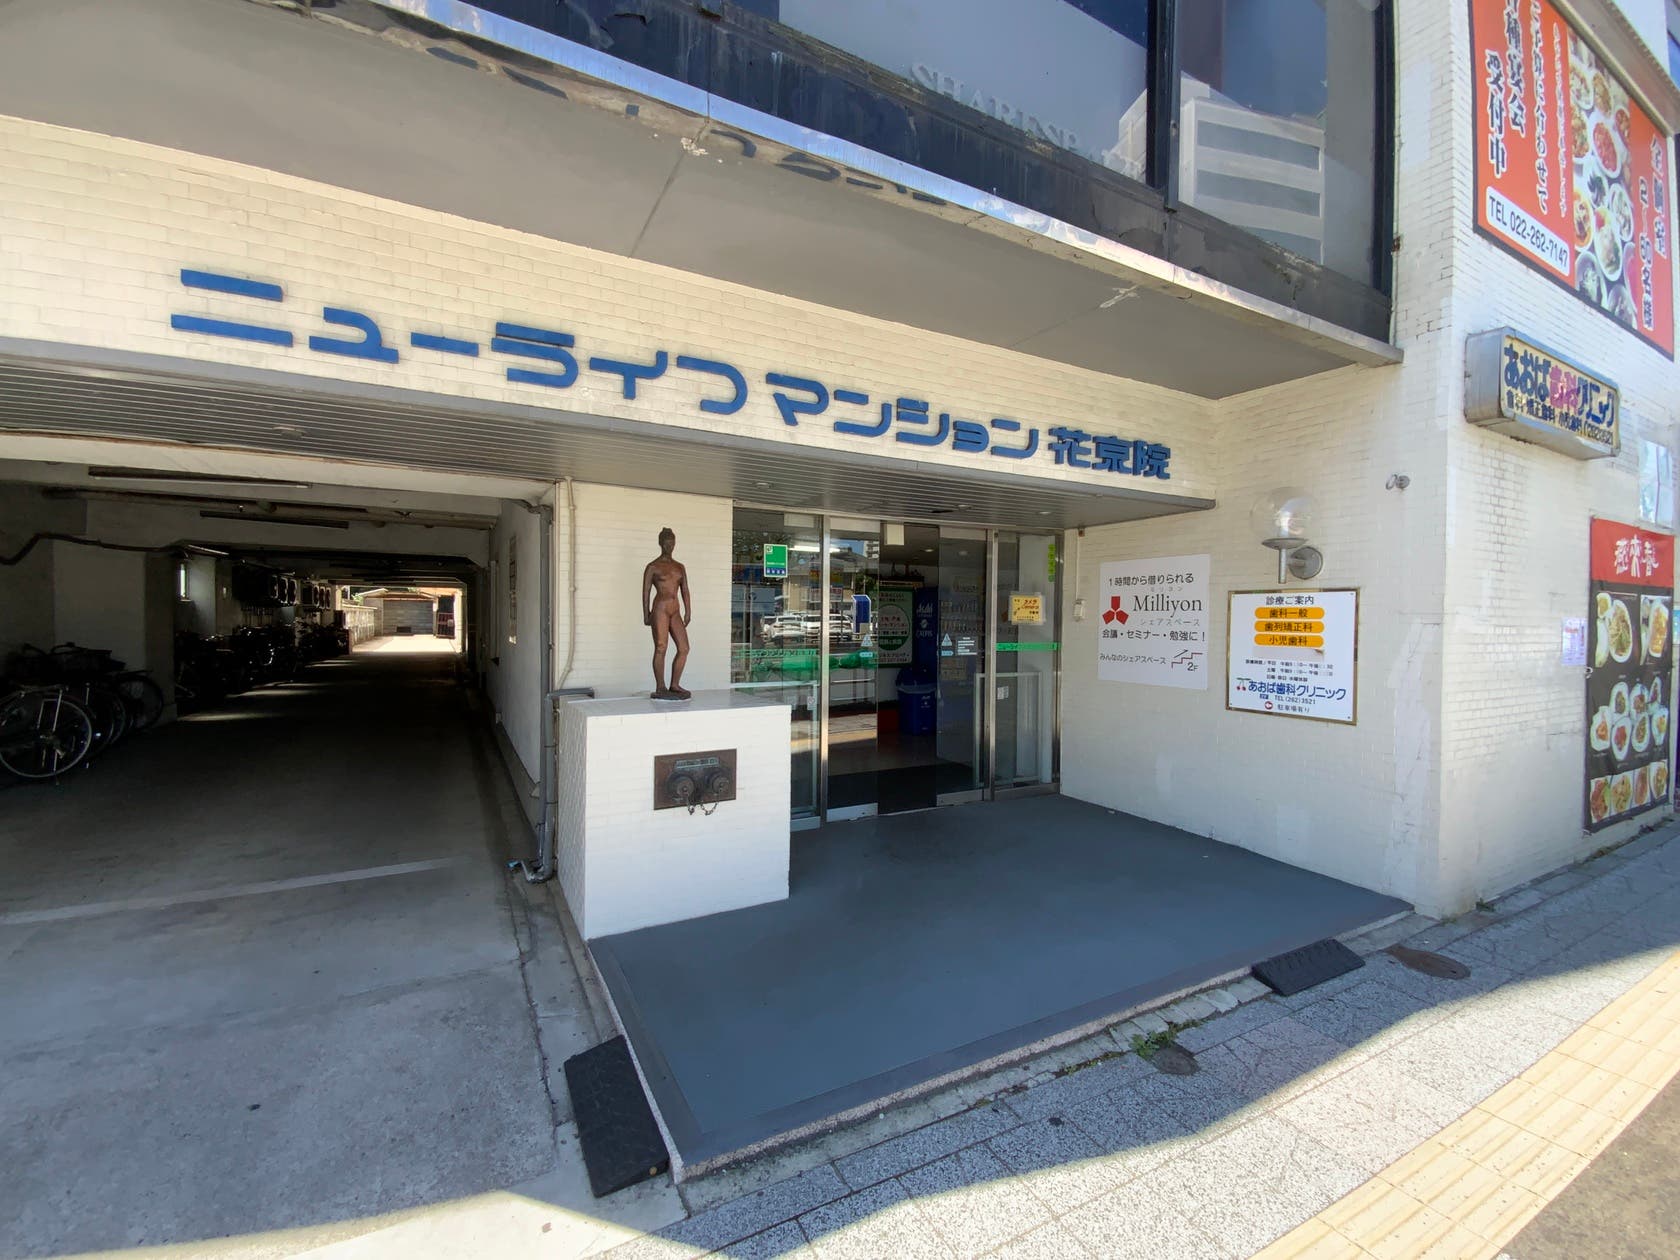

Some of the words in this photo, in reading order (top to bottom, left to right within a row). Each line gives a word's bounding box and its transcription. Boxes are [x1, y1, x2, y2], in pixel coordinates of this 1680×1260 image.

[1486, 50, 1507, 176] 受付中
[1488, 194, 1508, 227] TEL
[1509, 210, 1569, 268] 022-262-7147
[171, 268, 1171, 480] ニューライフマンション花京院
[1504, 343, 1615, 428] あおば歯科クリニック
[1109, 573, 1194, 587] 1時間から借りられる
[1133, 594, 1202, 618] Milliyon
[1265, 595, 1315, 606] 診療ご案内
[1269, 608, 1308, 619] 歯科一般
[1140, 618, 1200, 627] シェアスペース
[1264, 622, 1313, 633] 歯列矯正科
[1268, 635, 1308, 646] 小児歯科
[1100, 652, 1167, 665] みんなのシェアスペース
[1187, 661, 1200, 672] 2F
[1248, 680, 1346, 700] あおば歯科クリニック
